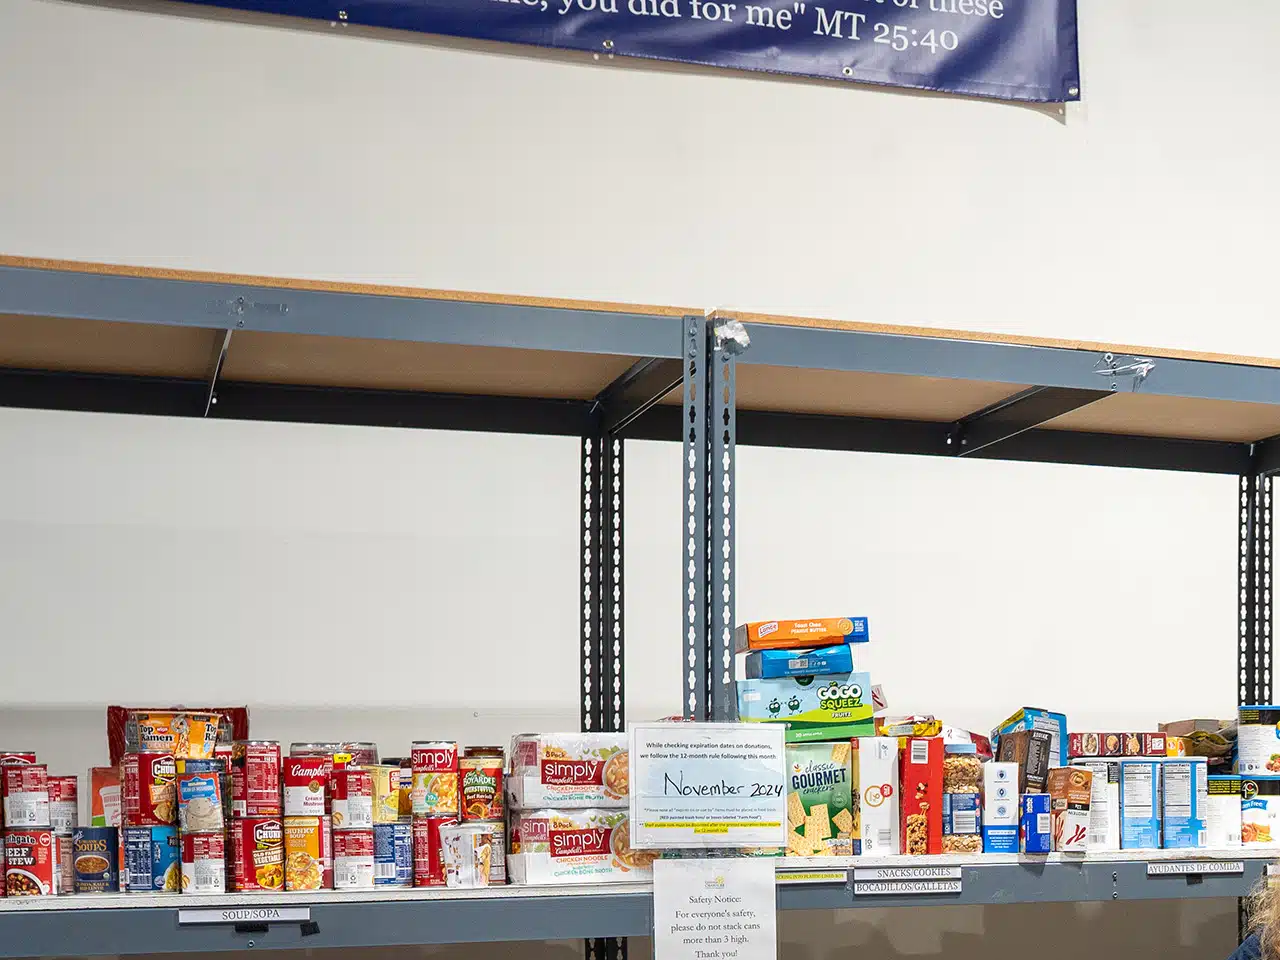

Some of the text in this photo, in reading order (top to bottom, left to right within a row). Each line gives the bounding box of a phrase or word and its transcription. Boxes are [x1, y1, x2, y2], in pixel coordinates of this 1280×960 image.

[692, 0, 737, 22] for
[814, 7, 865, 40] MT
[874, 22, 958, 53] 25:40
[140, 725, 153, 734] Top
[664, 742, 689, 750] checking
[412, 750, 454, 767] simply
[545, 762, 597, 780] simply
[805, 760, 835, 774] classic
[664, 770, 783, 797] November 2024
[792, 769, 846, 790] GOURMET
[803, 786, 833, 795] crackers
[554, 830, 604, 849] simply
[75, 840, 107, 851] SOUPS
[9, 858, 34, 866] STEW
[1149, 862, 1241, 873] AYUDANTES DE COMIDA
[878, 868, 950, 878] SNACKS/COOKIES
[857, 882, 958, 892] BOCADILLOS/GALLETAS
[689, 895, 741, 905] Safety Notice:
[222, 909, 280, 920] SOUP/SOPA
[691, 910, 730, 920] everyone's
[733, 910, 755, 919] safety,
[671, 923, 694, 934] please
[696, 923, 706, 931] do
[708, 923, 721, 931] not
[731, 935, 749, 944] high.
[695, 950, 738, 959] Thank you!
